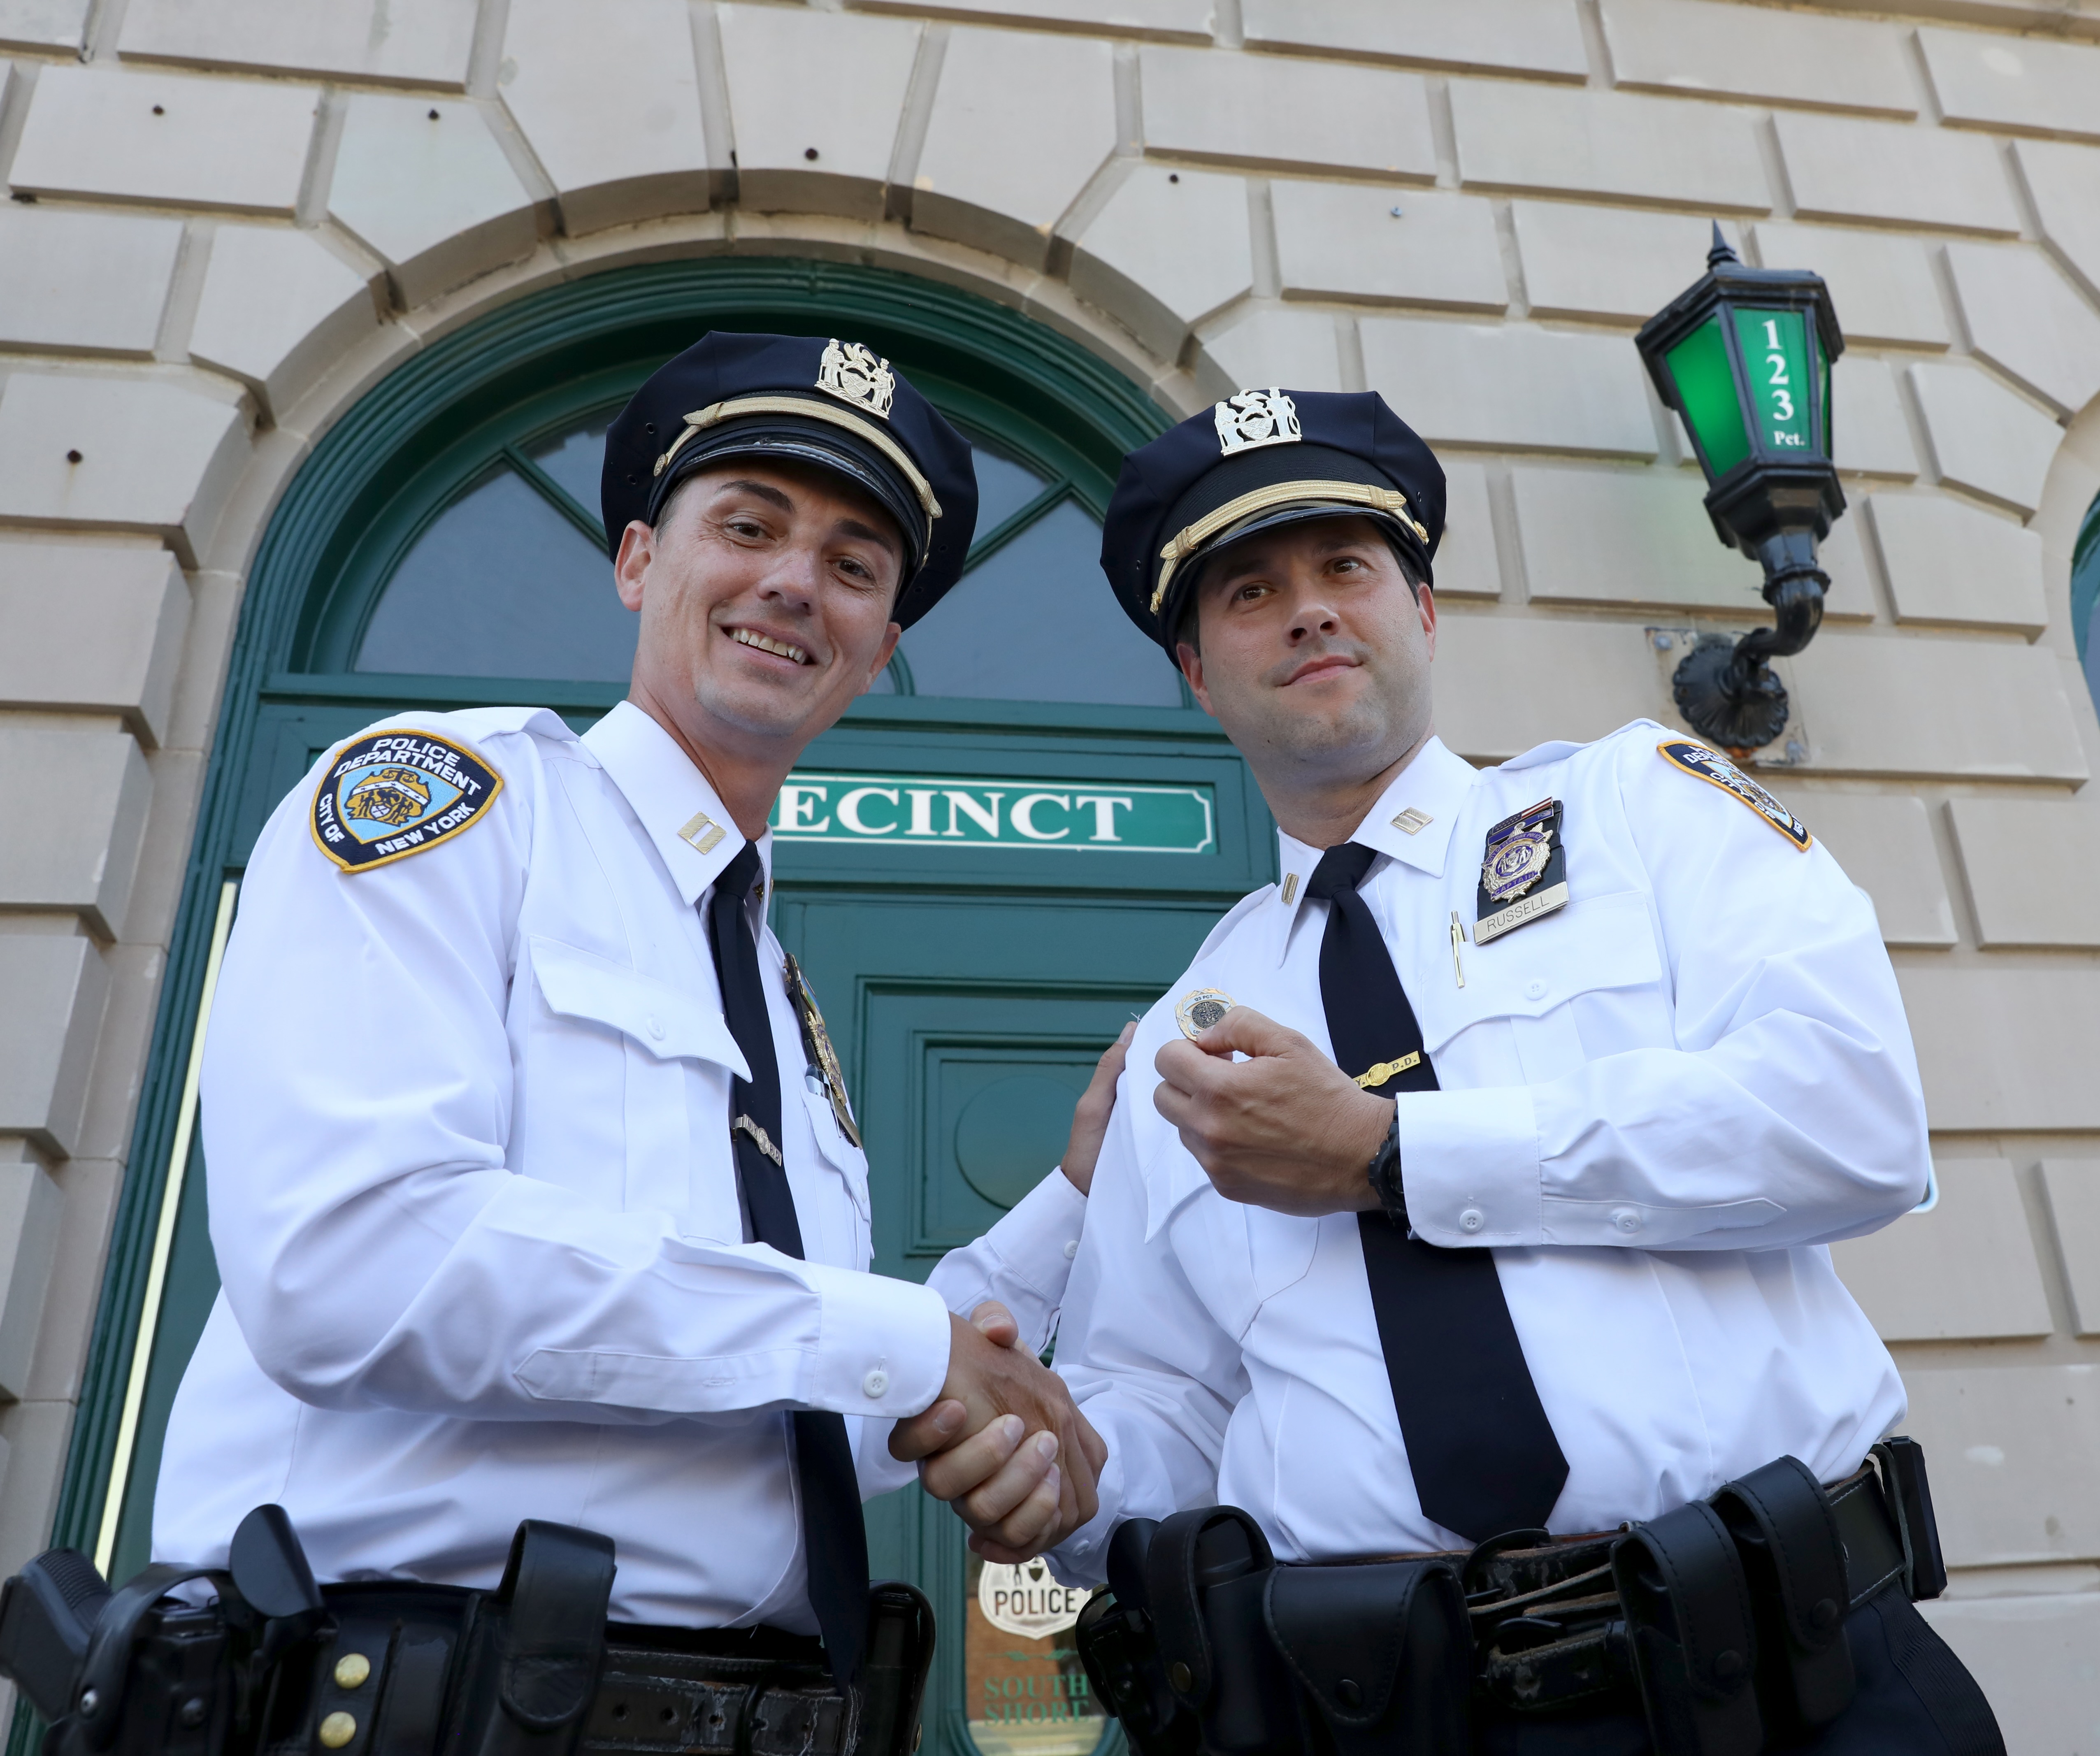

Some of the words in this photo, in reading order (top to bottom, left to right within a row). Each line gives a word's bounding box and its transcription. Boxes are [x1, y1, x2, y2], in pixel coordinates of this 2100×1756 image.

[1762, 319, 1794, 421] 123
[1773, 430, 1805, 446] Pct.
[371, 738, 460, 767] POLICE
[333, 750, 482, 796] DEPARTMENT
[319, 793, 334, 827] CITY
[1710, 772, 1750, 797] CITY
[1754, 801, 1776, 819] OF
[374, 828, 425, 855] NEW
[423, 801, 476, 835] YORK
[776, 785, 1133, 841] ECINCT
[324, 825, 346, 843] OF
[1495, 872, 1534, 895] CAPTAIN
[1487, 896, 1550, 932] RUSSELL
[1356, 1078, 1366, 1087] Y.
[1392, 1057, 1417, 1071] P.D.
[995, 1588, 1077, 1616] POLICE
[984, 1673, 1089, 1700] SOUTH
